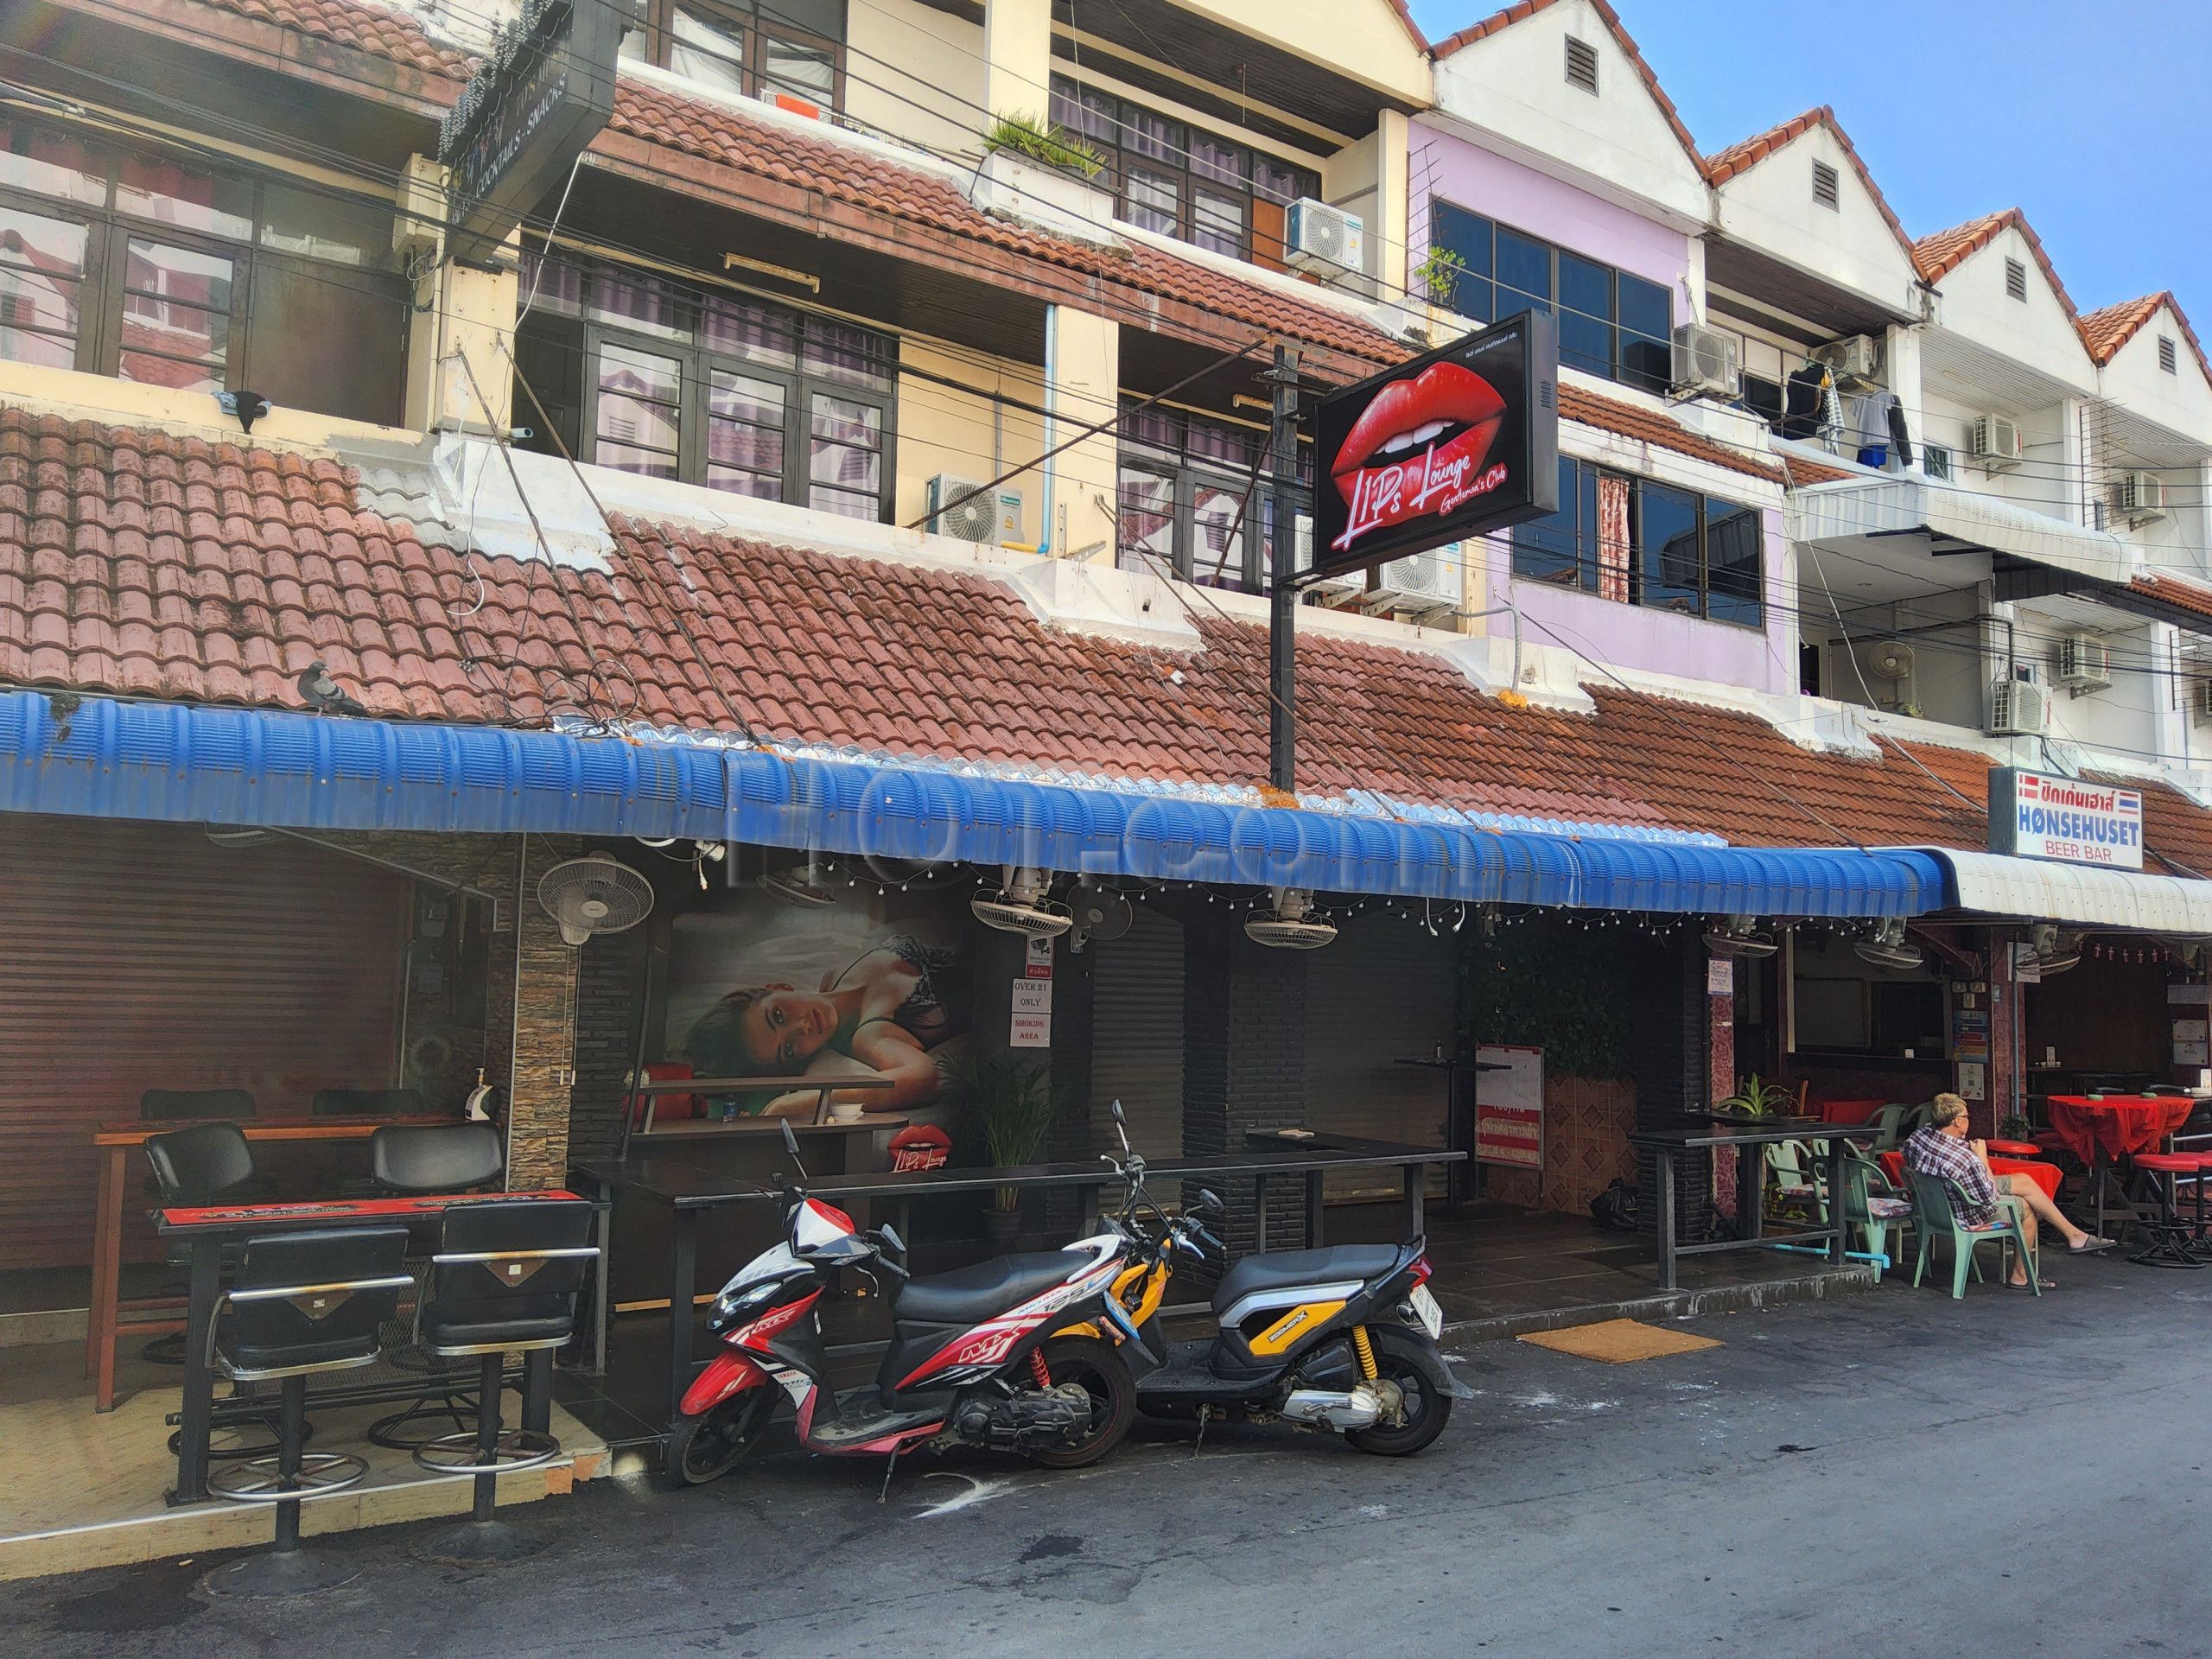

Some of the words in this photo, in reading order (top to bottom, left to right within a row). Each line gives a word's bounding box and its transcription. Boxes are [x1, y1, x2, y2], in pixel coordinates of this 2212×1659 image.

[1487, 467, 1506, 489] Club
[1333, 467, 1403, 548] LIPs
[1409, 444, 1470, 510] Lounge
[2018, 804, 2139, 847] HØNSEHUSET
[2045, 841, 2080, 858] BEER
[2085, 845, 2112, 862] BAR
[1014, 982, 1036, 992] OVER
[1038, 983, 1047, 992] 21
[1020, 998, 1041, 1007] ONLY
[1014, 1020, 1045, 1028] SMOKING
[922, 1148, 948, 1171] Lounge
[777, 1370, 797, 1379] YAMAHA
